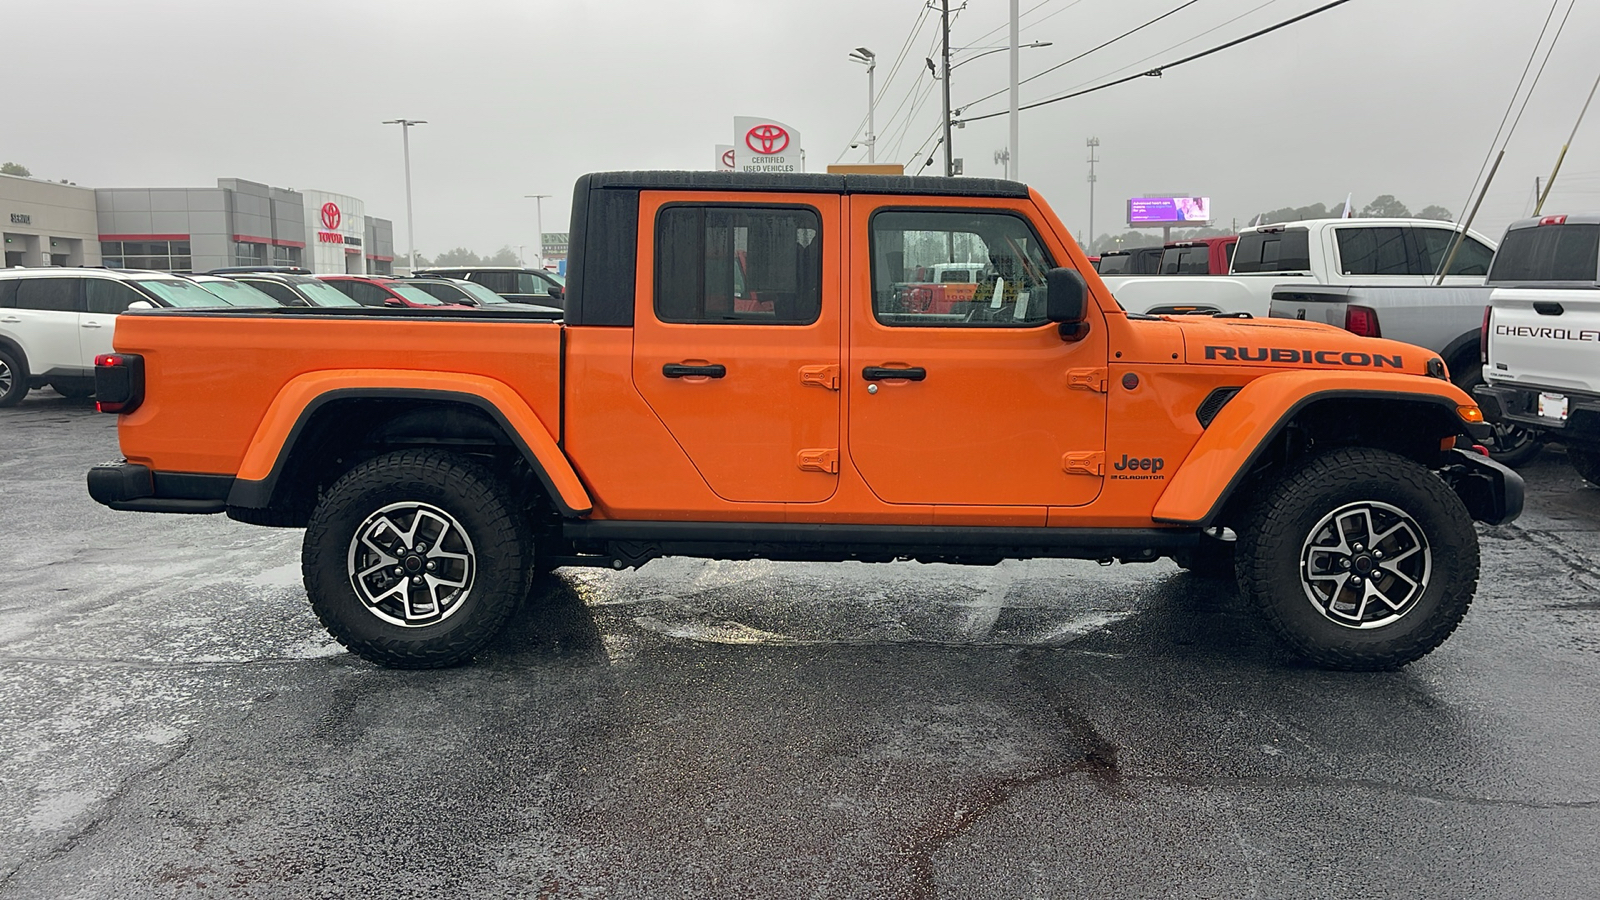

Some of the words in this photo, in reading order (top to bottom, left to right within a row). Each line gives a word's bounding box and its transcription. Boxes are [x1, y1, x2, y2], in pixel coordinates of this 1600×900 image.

[751, 156, 785, 164] CERTIFIED
[318, 231, 344, 244] TOYOTA
[1496, 325, 1600, 342] CHEVROLET
[1204, 345, 1404, 369] RUBICON
[1114, 454, 1165, 473] Jeep
